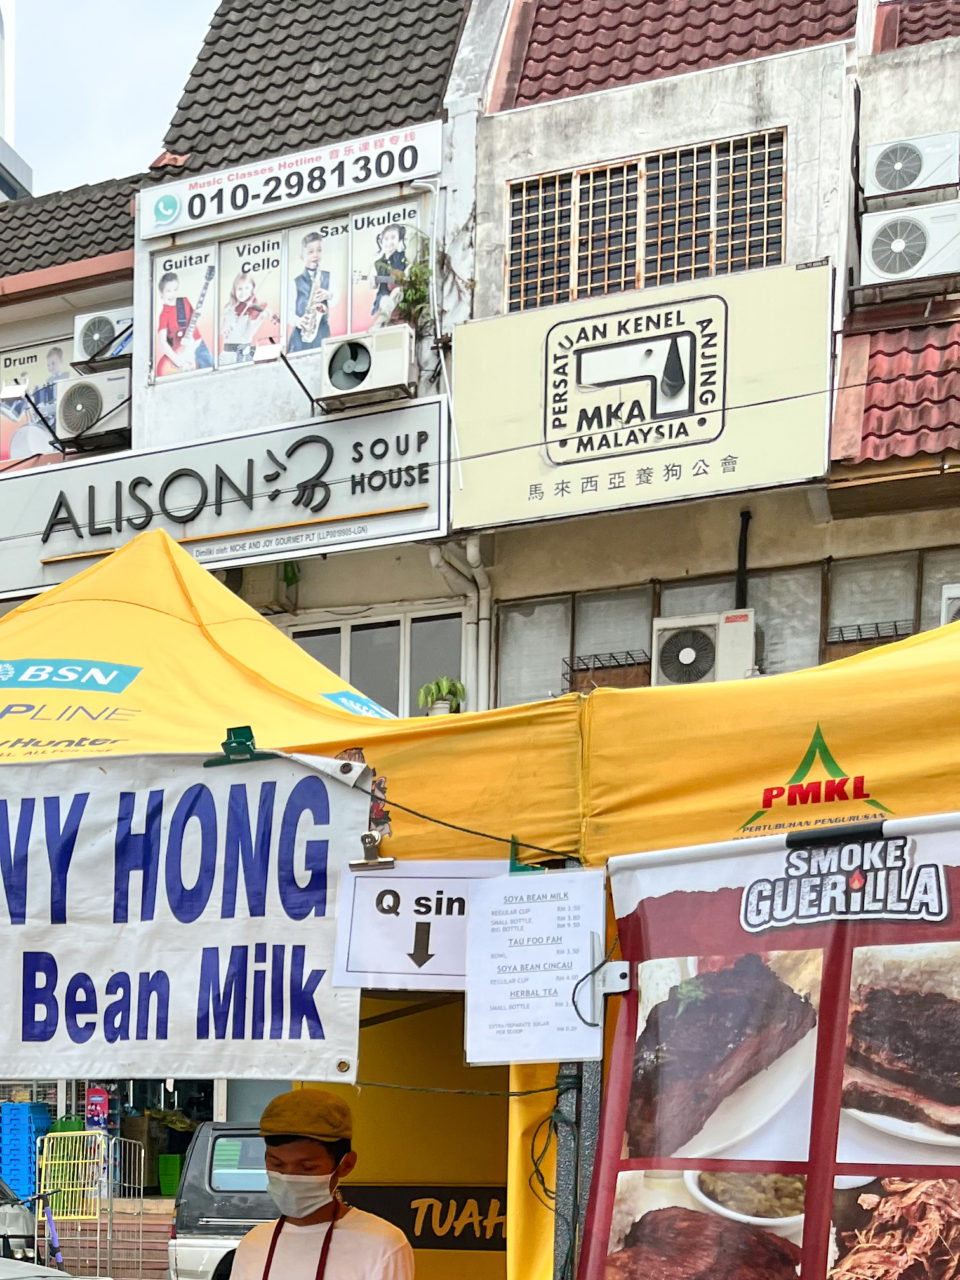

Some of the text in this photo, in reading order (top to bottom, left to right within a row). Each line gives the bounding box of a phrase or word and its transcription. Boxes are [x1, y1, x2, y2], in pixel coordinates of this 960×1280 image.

[187, 144, 419, 220] 010-2981300
[189, 153, 322, 191] Music Classes Hotline
[320, 222, 349, 239] Sax
[354, 207, 417, 231] Ukulele
[163, 252, 210, 272] Guitar
[236, 239, 280, 258] Violin
[241, 256, 280, 275] Cello
[3, 353, 38, 369] Drum
[617, 309, 685, 337] KENEL
[696, 316, 717, 406] ANJING
[577, 399, 645, 432] MKA
[352, 430, 430, 463] SOUP
[576, 421, 689, 454] MALAYSIA
[351, 464, 429, 495] HOUSE
[527, 454, 739, 501] 馬來西亞養狗公會
[41, 456, 254, 543] ALISON
[248, 541, 261, 550] AND
[262, 539, 274, 549] JOY
[17, 664, 121, 687] BSN
[762, 775, 870, 809] PMKL
[742, 812, 887, 833] PERTUBUHAN PENGURUSAN
[113, 774, 333, 926] HONG
[787, 838, 905, 877] SMOKE
[375, 888, 401, 917] Q
[503, 891, 568, 904] SOYA BEAN MILK
[508, 935, 563, 946] TAU FOO FAH
[496, 961, 573, 973] SOYA BEAN CINCAU
[22, 950, 170, 1045] Bean
[196, 942, 327, 1042] Milk
[509, 988, 559, 998] HERBAL TEA
[410, 1197, 507, 1240] TUAH
